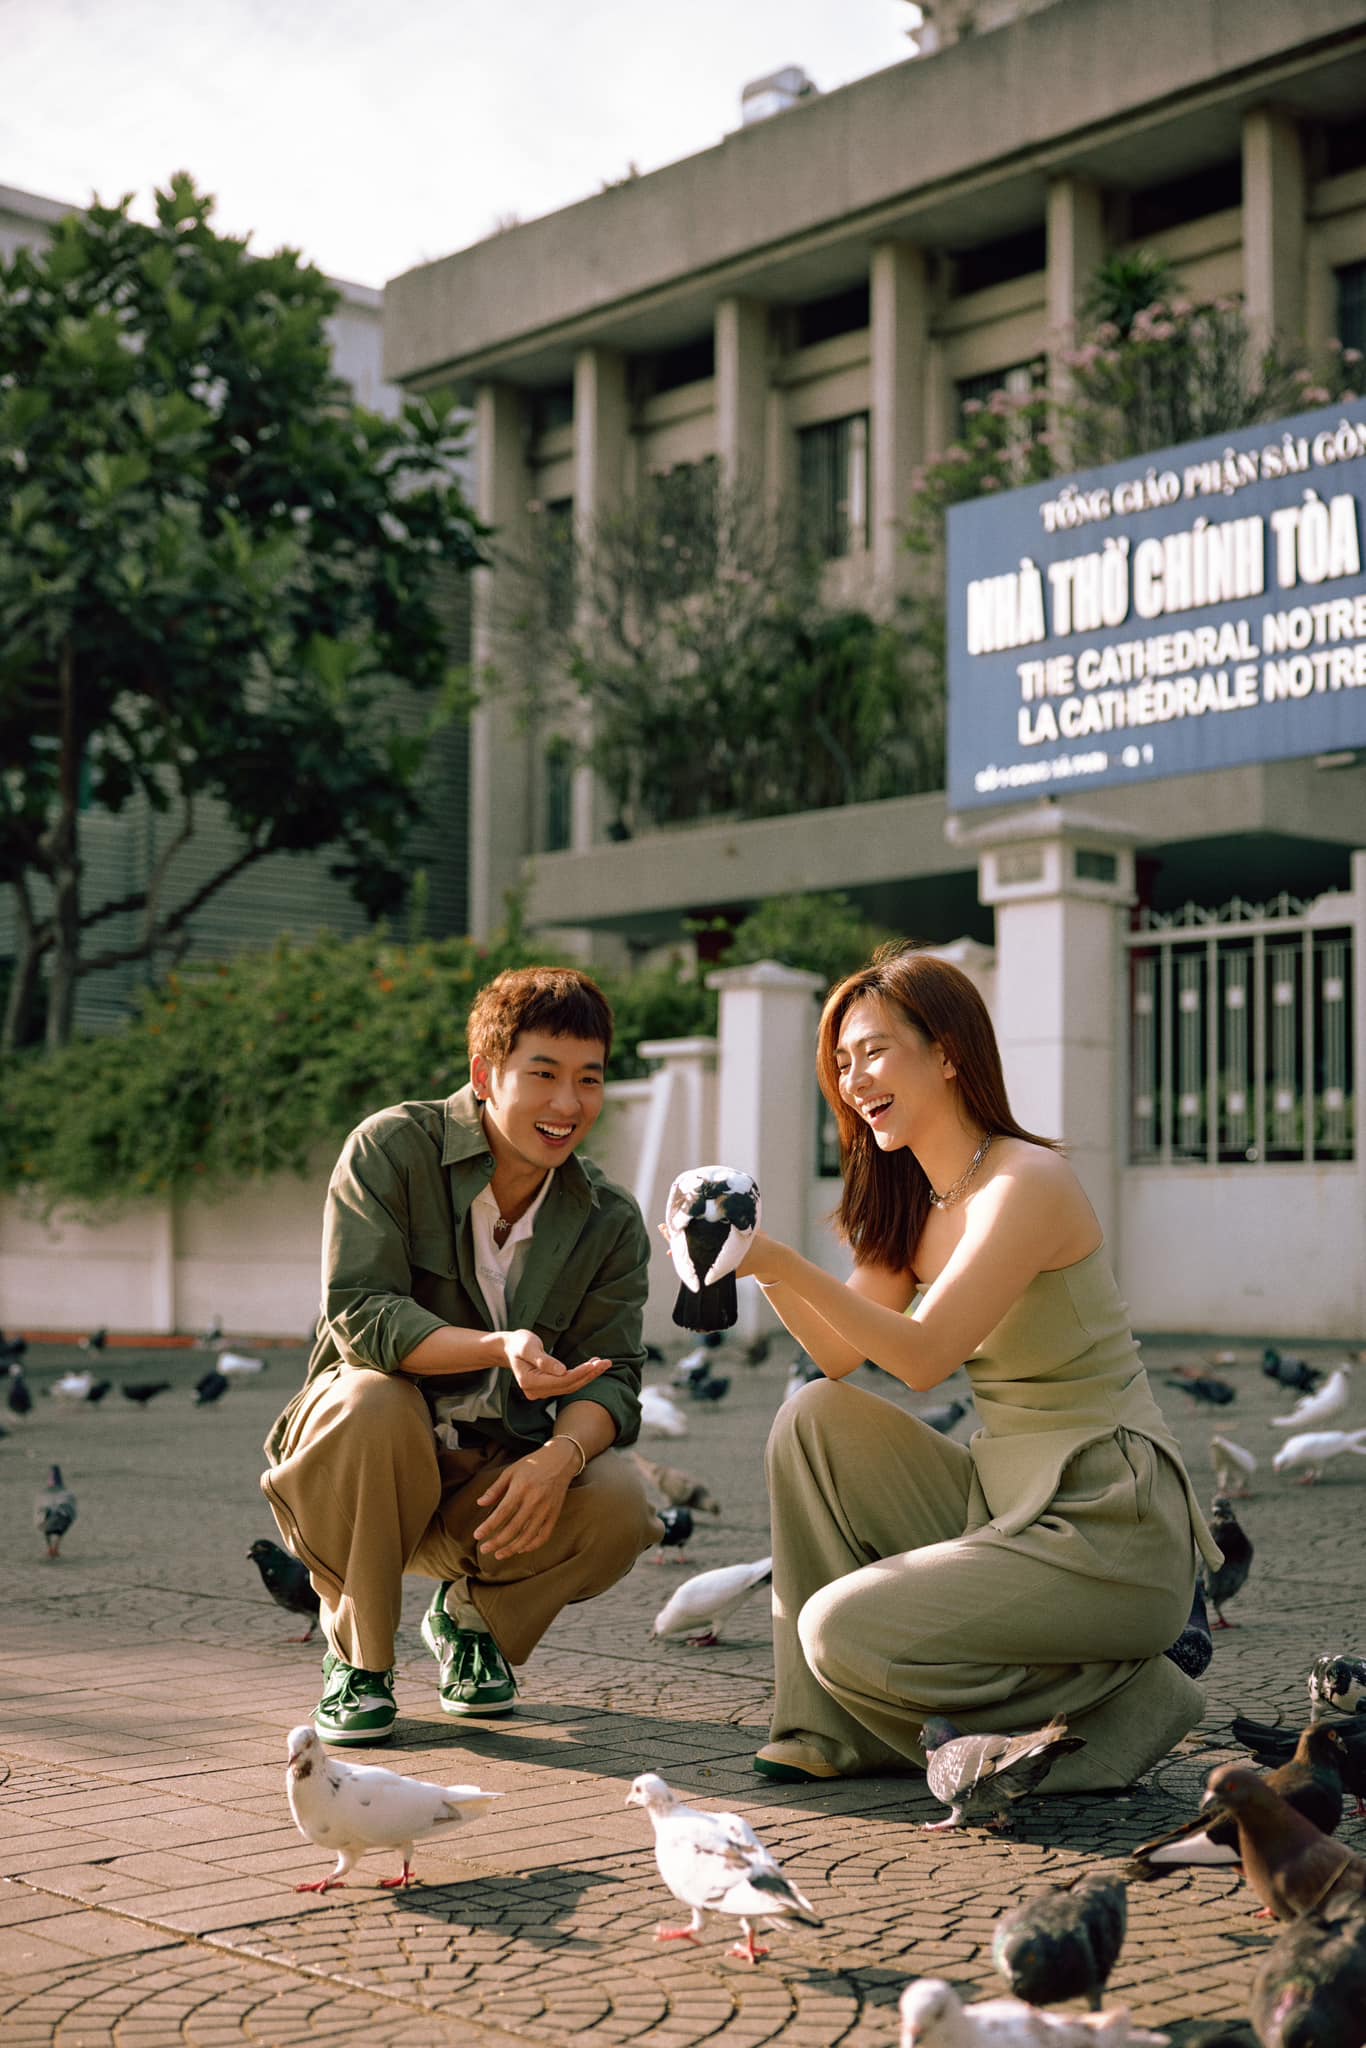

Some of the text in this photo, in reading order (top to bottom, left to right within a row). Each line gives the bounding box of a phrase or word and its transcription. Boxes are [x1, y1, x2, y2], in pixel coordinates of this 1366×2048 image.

[967, 488, 1360, 655] NHÀ THỜ CHÍNH TÒA
[1017, 655, 1074, 701] THE
[1077, 619, 1260, 690] CATHEDRAL
[1018, 703, 1058, 745] LA
[1059, 664, 1259, 738] CATHÉDRALE
